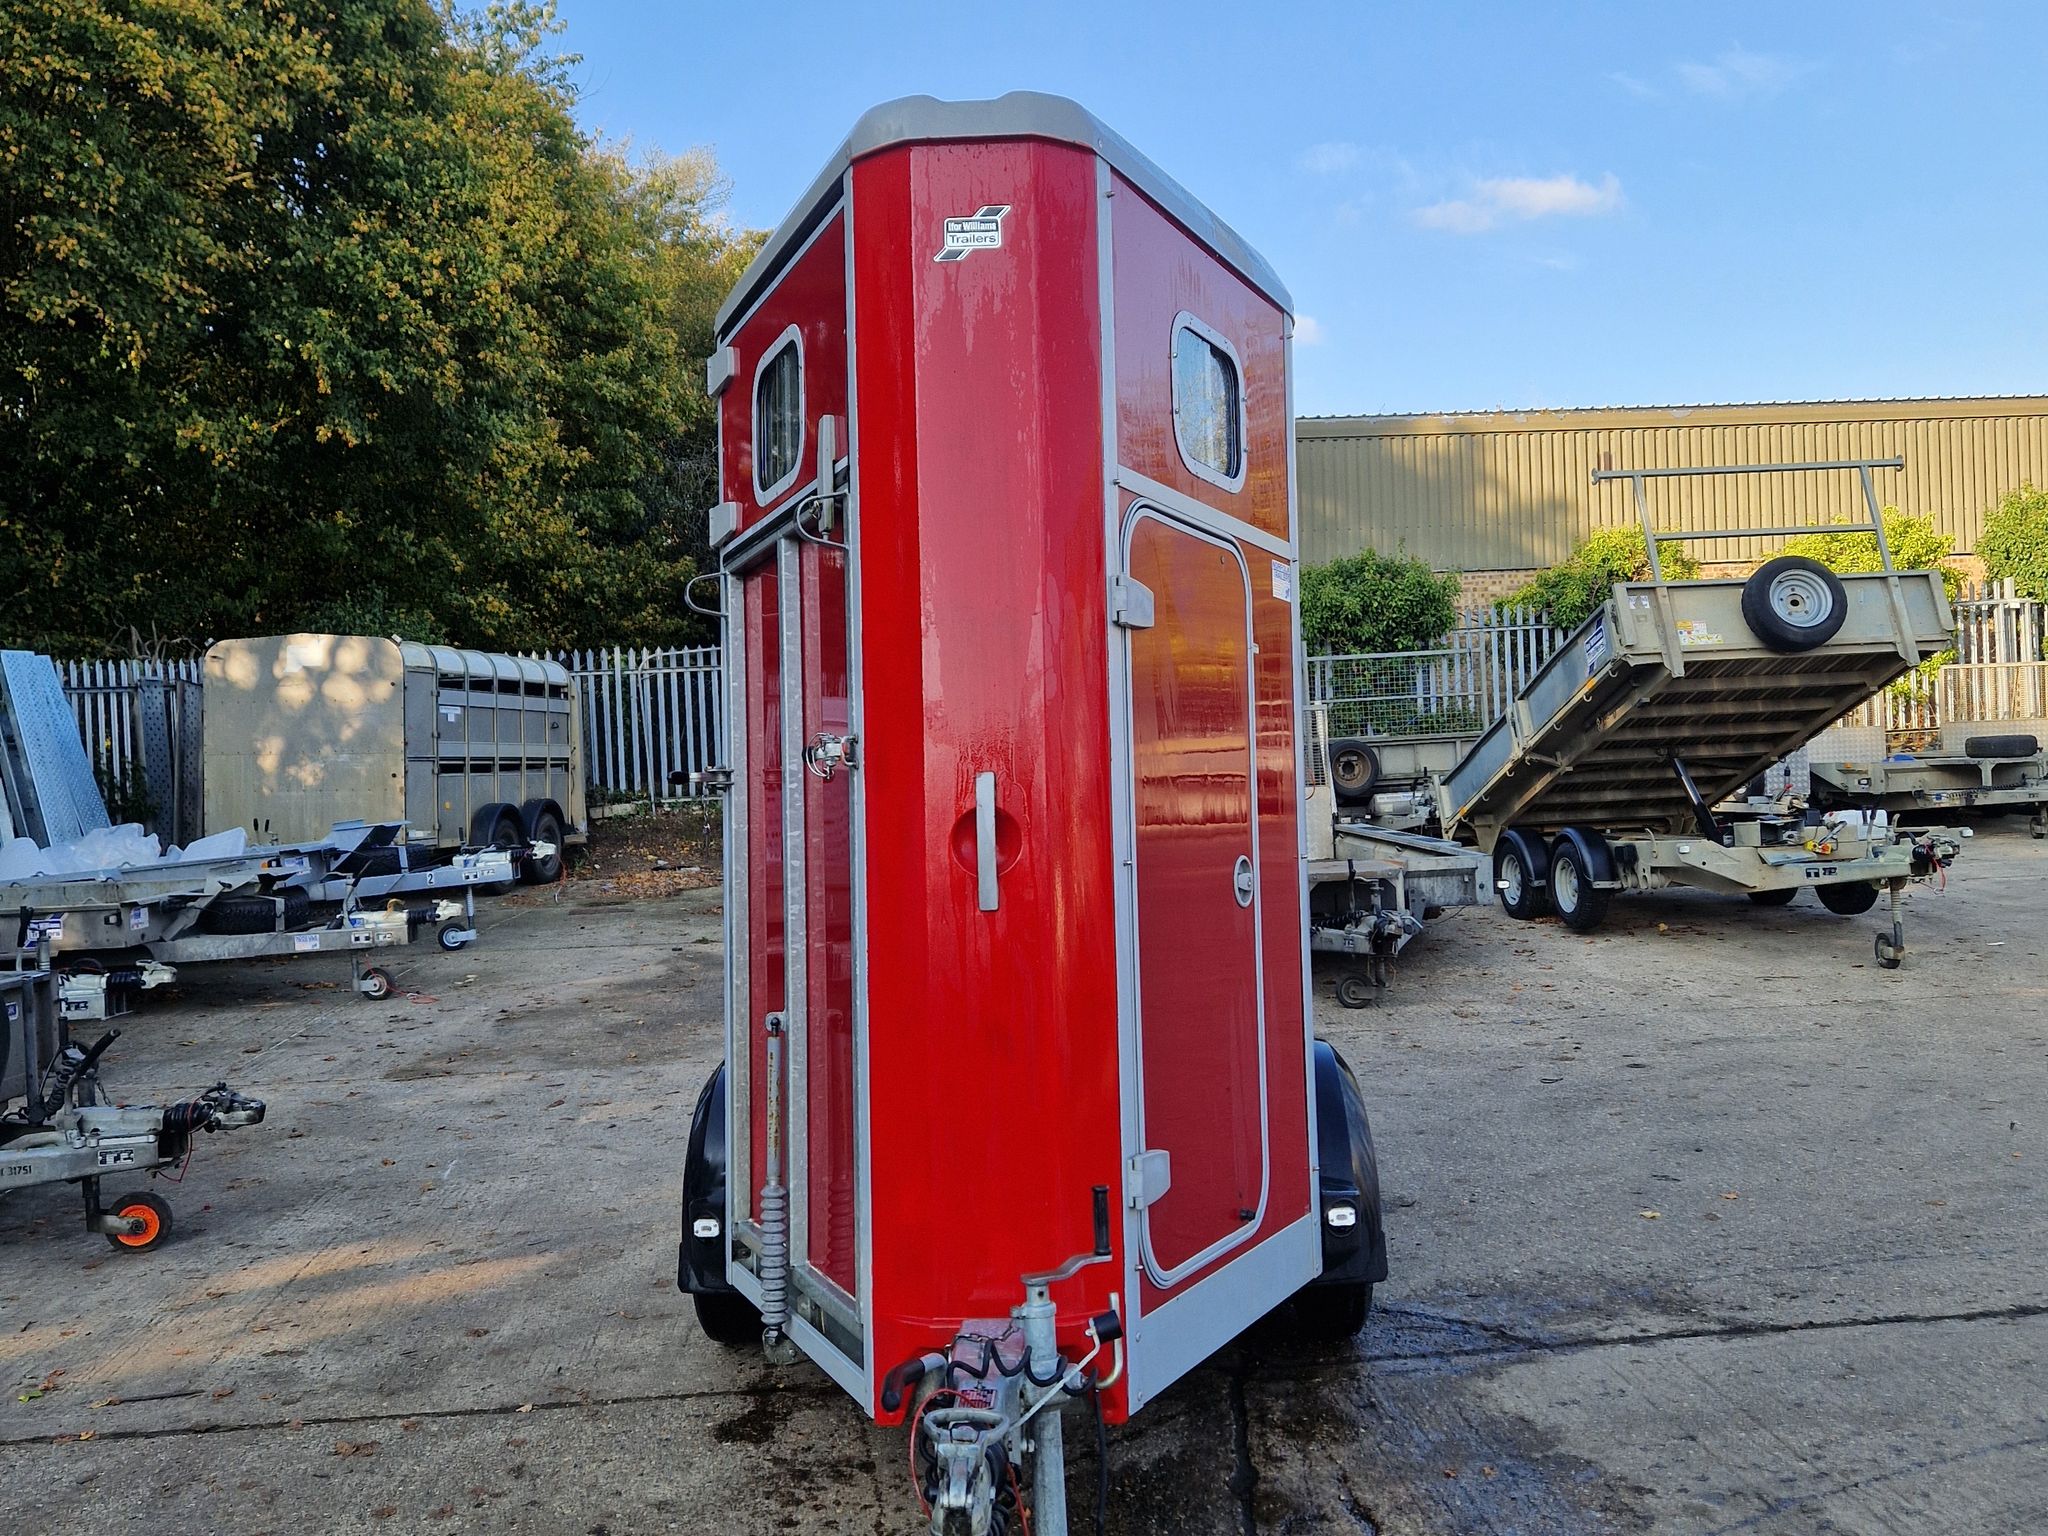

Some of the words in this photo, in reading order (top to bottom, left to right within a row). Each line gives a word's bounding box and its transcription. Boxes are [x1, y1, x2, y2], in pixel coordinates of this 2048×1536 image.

[948, 222, 962, 232] Ifor
[962, 221, 997, 231] Williams
[949, 234, 997, 244] Trailers
[427, 873, 434, 884] 2
